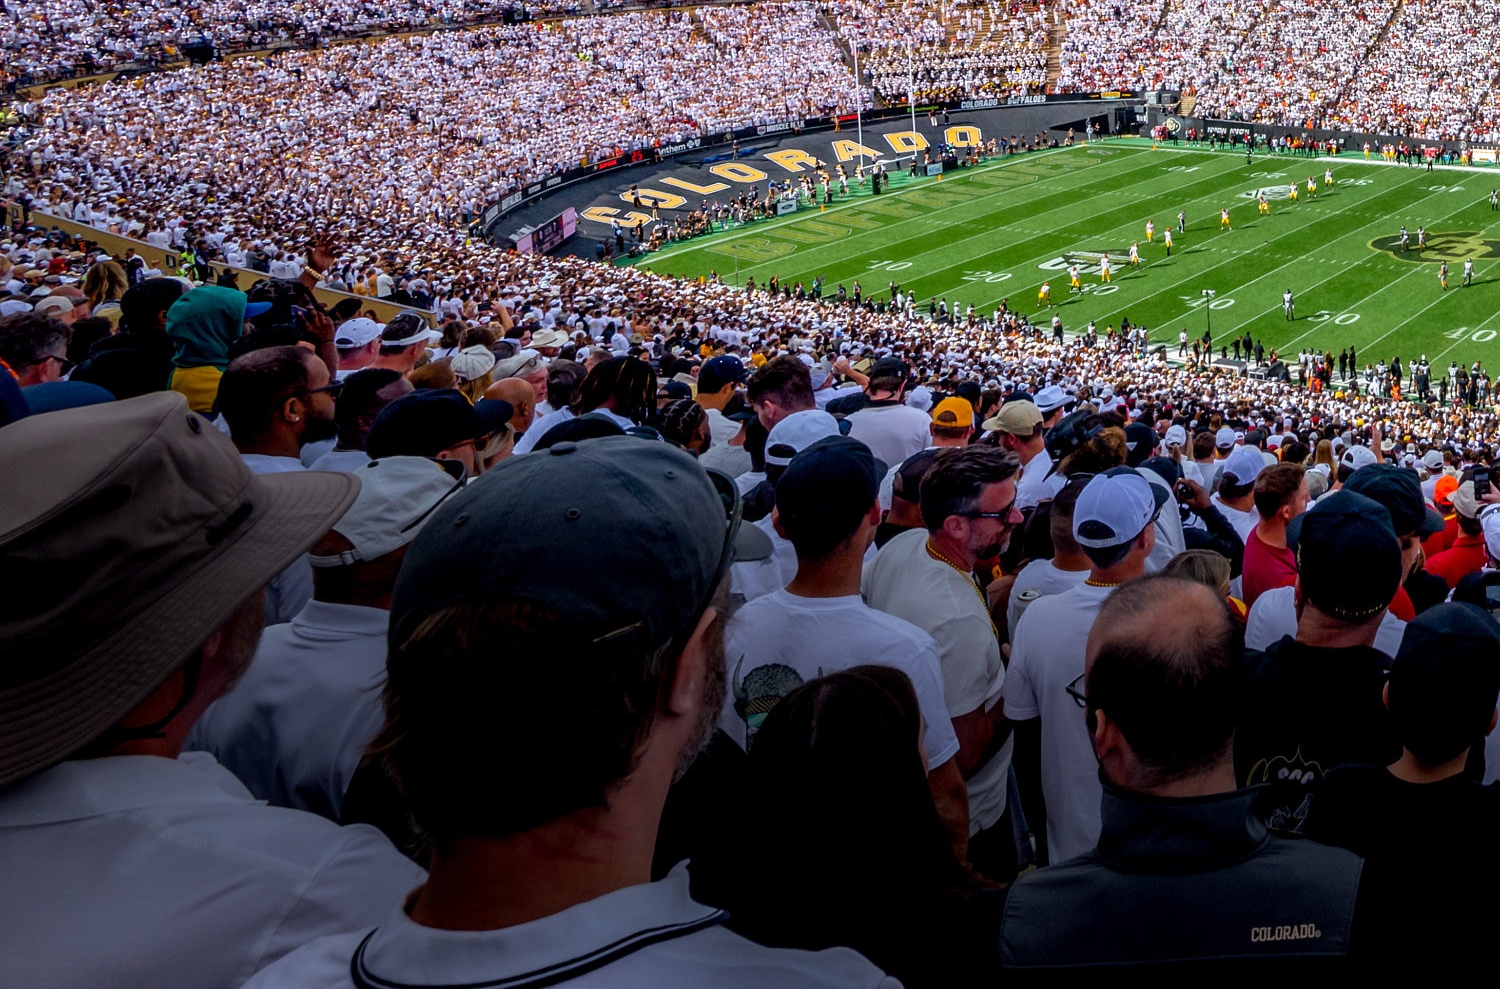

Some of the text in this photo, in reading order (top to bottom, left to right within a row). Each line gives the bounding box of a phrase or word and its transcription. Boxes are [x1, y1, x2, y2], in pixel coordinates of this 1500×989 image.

[961, 95, 1047, 109] COLORADO BUFFALOES
[766, 120, 805, 132] MUSCLE MLK
[632, 150, 643, 162] 25
[580, 125, 983, 228] COLORADO
[877, 261, 913, 271] 10
[970, 271, 1012, 283] 20
[1077, 283, 1119, 296] 30
[1195, 296, 1235, 310] 40
[1309, 312, 1361, 326] 50
[1443, 327, 1499, 343] 40
[1250, 923, 1316, 942] COLORADO
